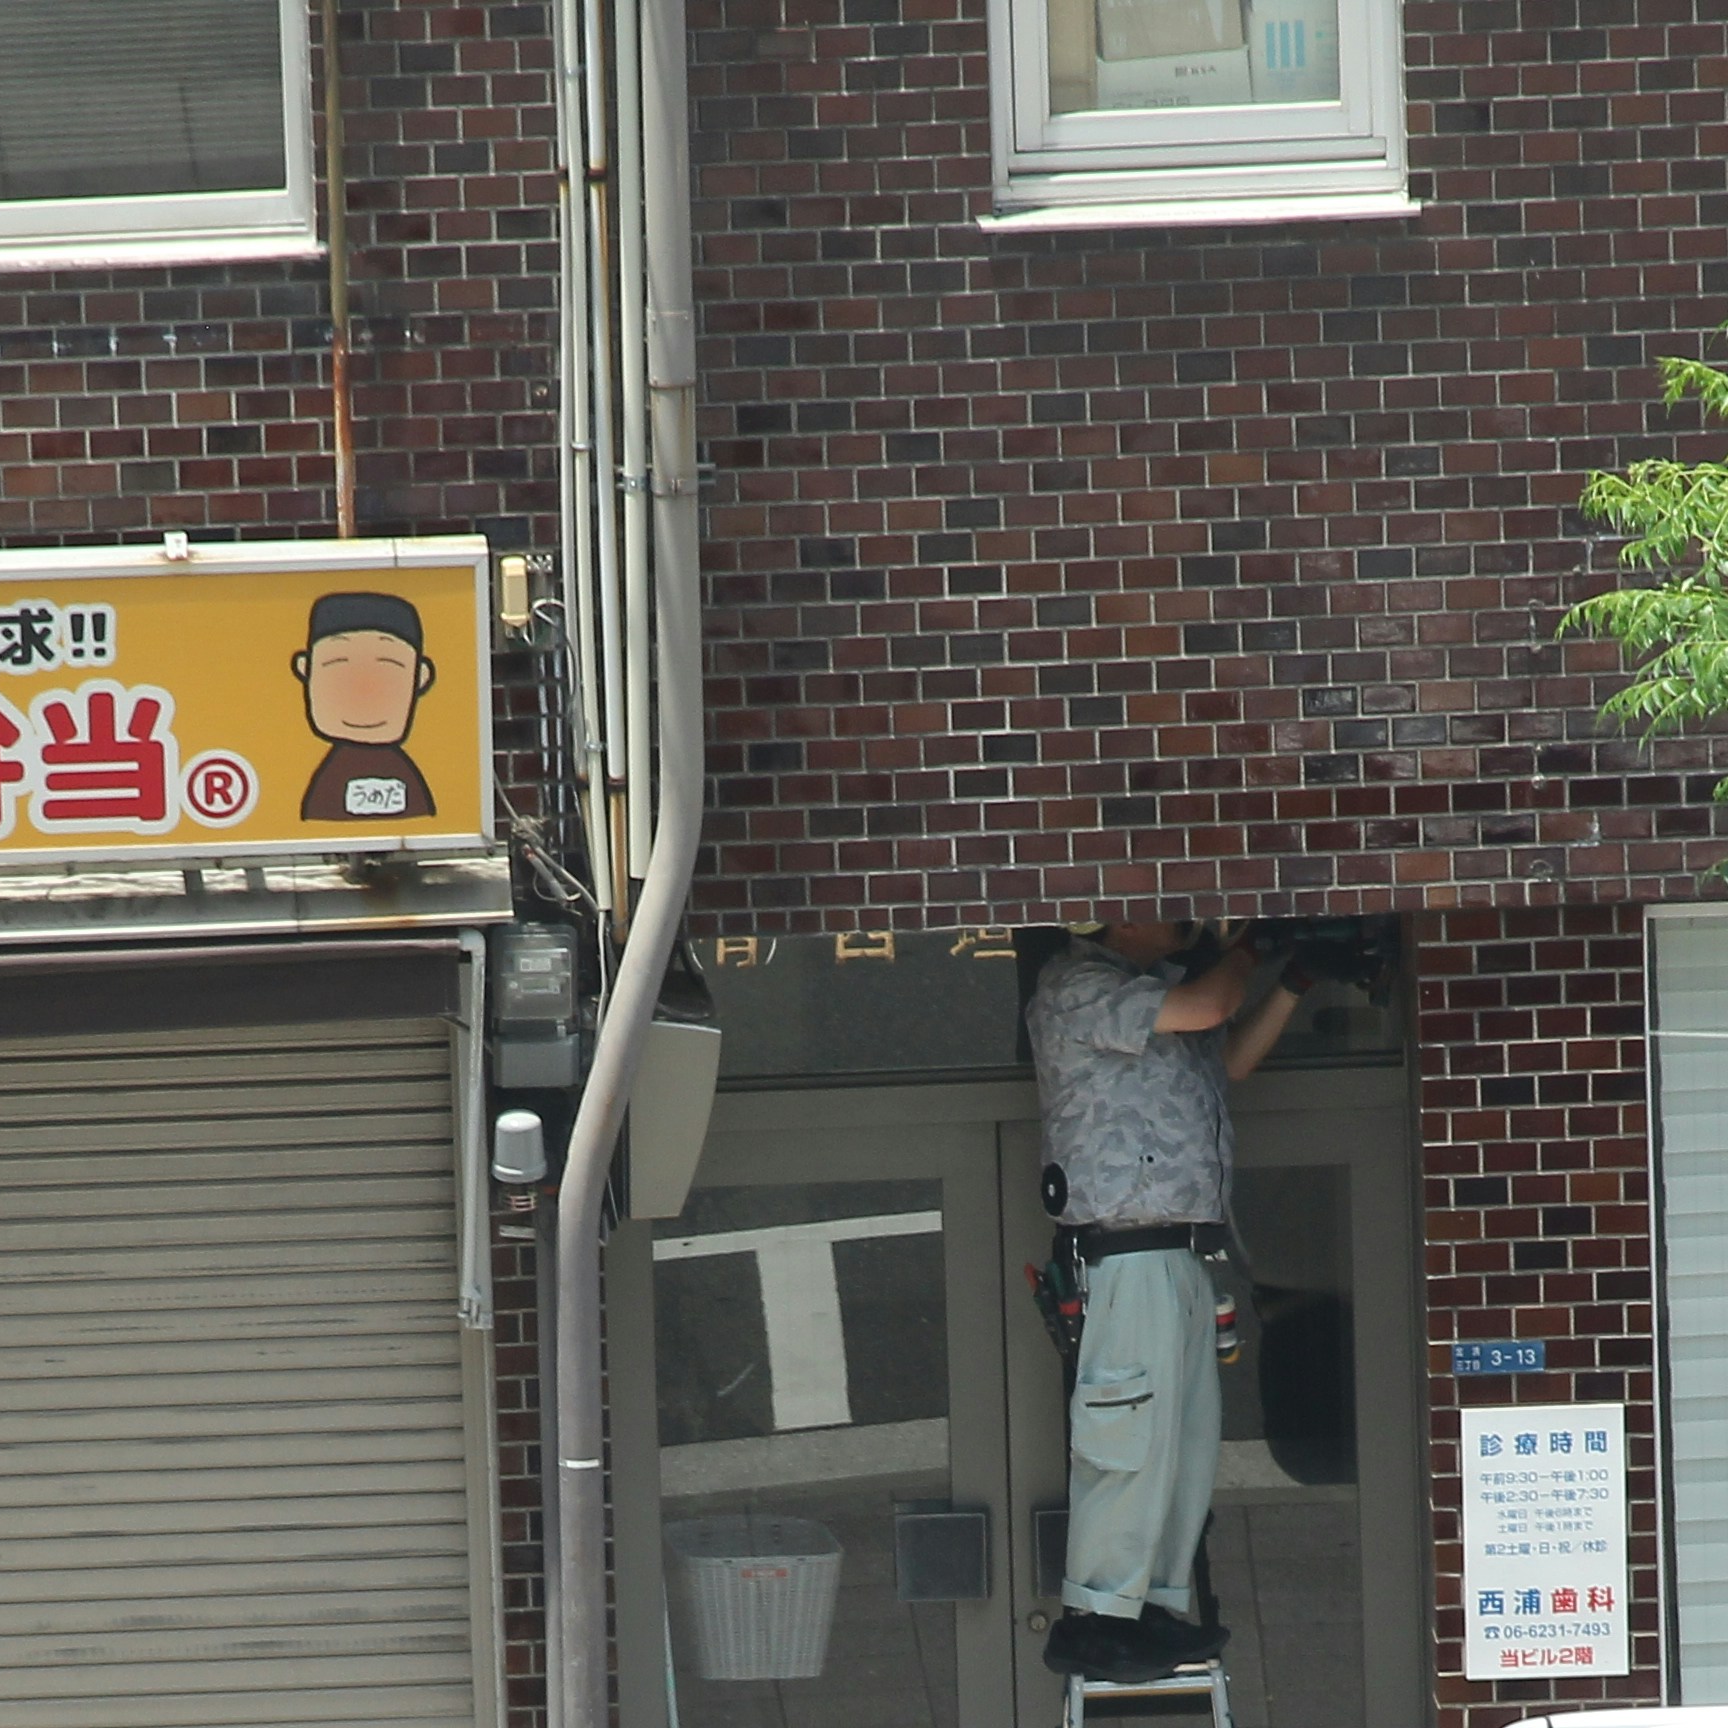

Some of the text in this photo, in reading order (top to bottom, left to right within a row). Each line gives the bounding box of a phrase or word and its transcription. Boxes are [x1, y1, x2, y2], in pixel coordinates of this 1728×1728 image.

[352, 782, 405, 809] うめだ
[1490, 1348, 1536, 1366] 3-13
[1479, 1430, 1608, 1457] 診療時間
[1497, 1522, 1528, 1534] 土曜日
[1477, 1586, 1615, 1616] 西浦歯科
[1503, 1622, 1611, 1639] 06-6231-7493
[1500, 1646, 1594, 1668] 当ビル2階
